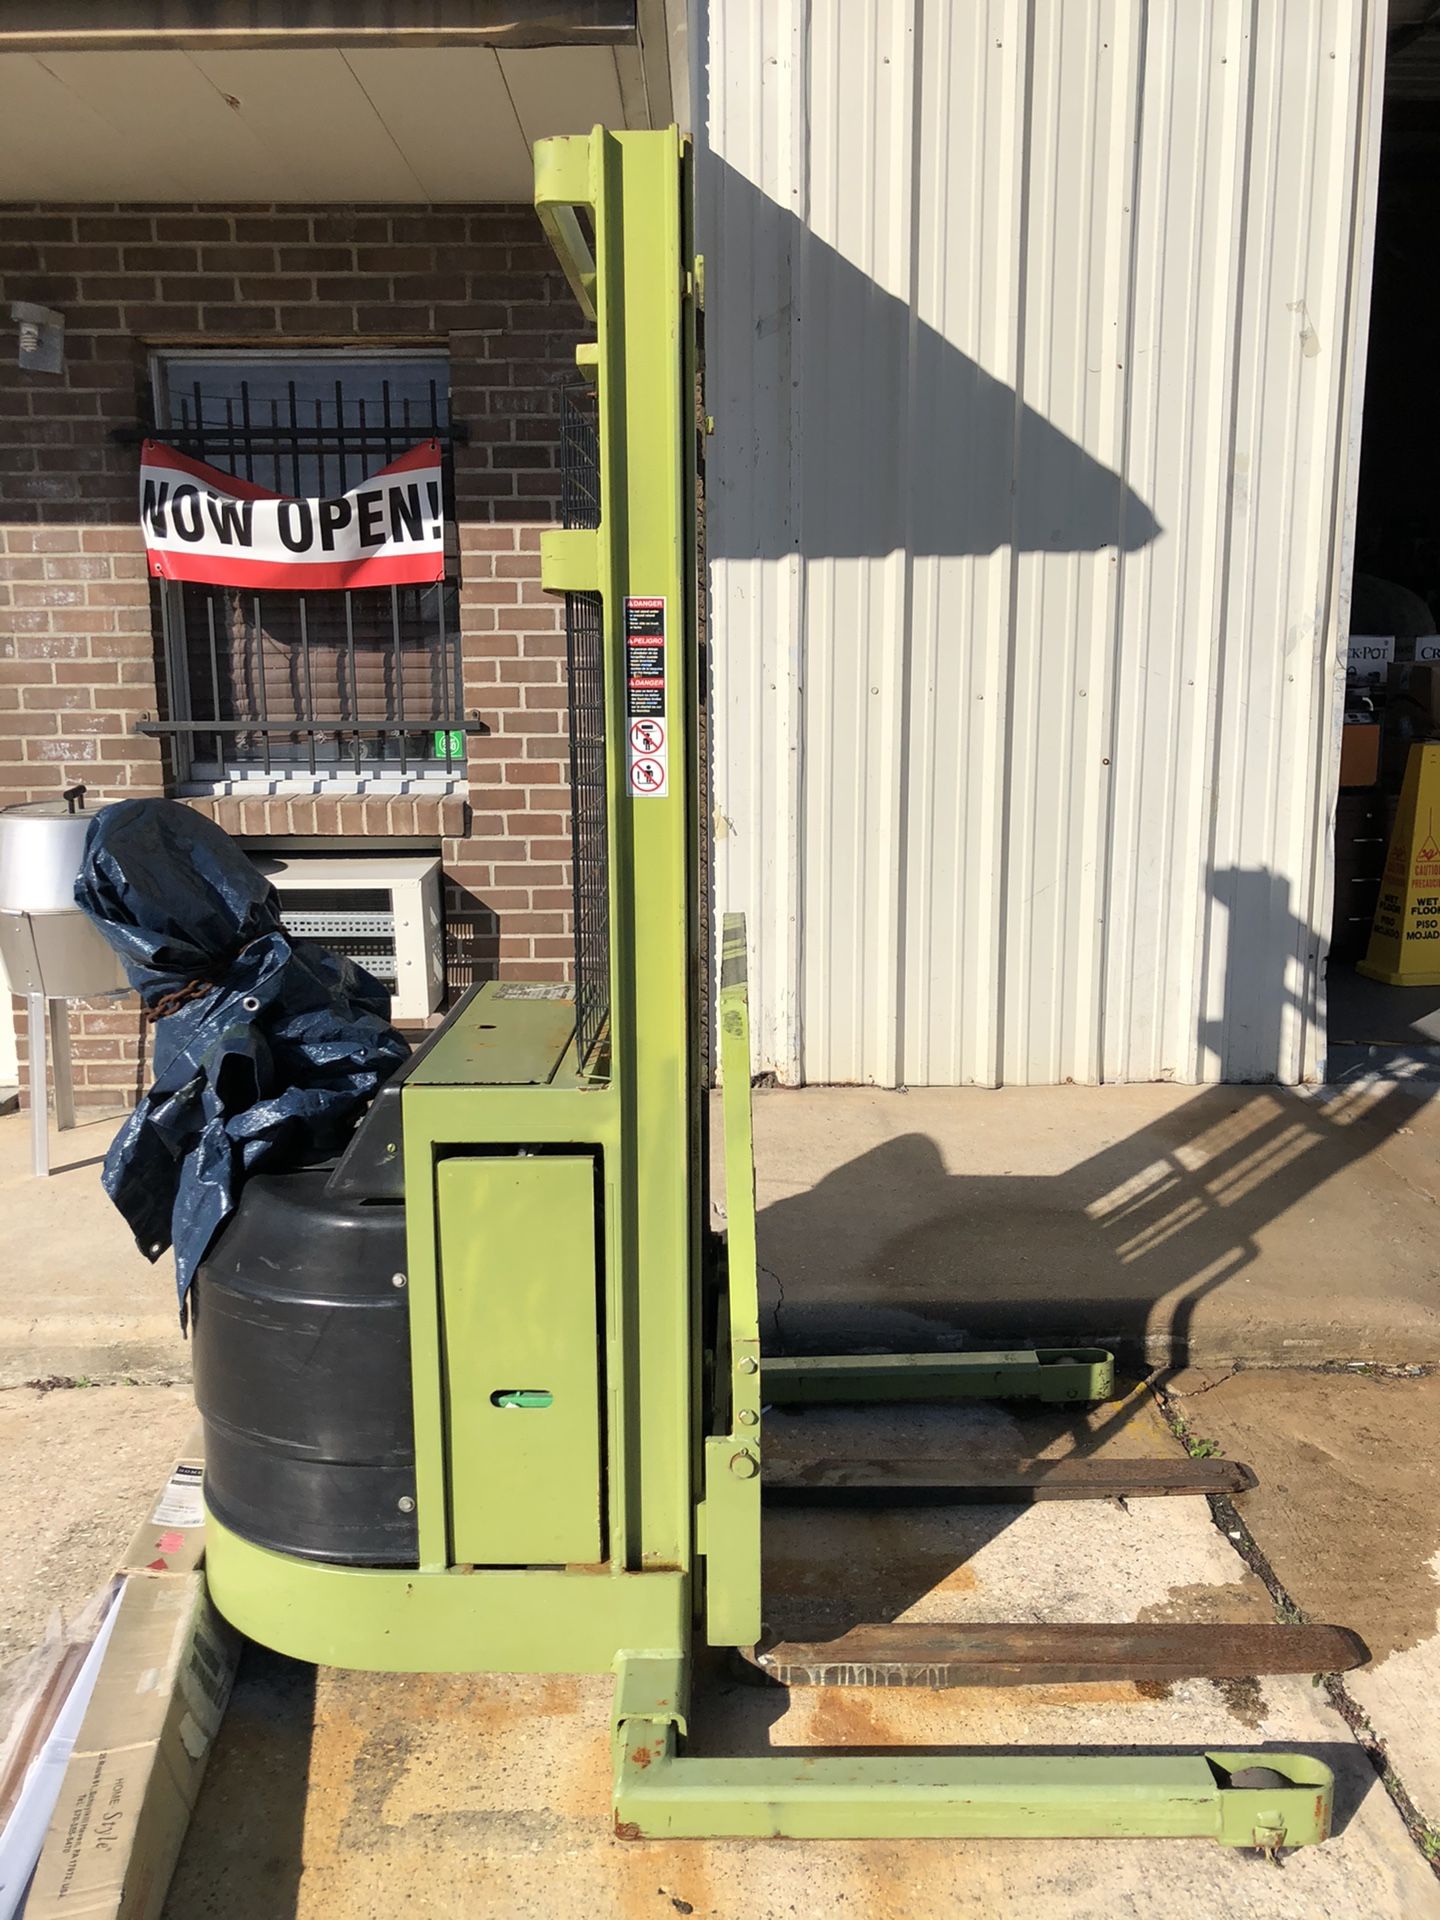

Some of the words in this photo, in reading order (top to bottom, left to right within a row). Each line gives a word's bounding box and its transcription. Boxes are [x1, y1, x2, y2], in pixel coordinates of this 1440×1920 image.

[143, 479, 253, 547] NOW
[277, 481, 442, 553] OPEN!
[633, 637, 663, 645] PELIGRO
[1415, 863, 1440, 876] CAUTIO
[1416, 897, 1439, 906] WET
[1416, 919, 1438, 929] PISO
[1407, 930, 1440, 940] MOJAD
[109, 1777, 124, 1806] HOME
[94, 1811, 124, 1849] Style
